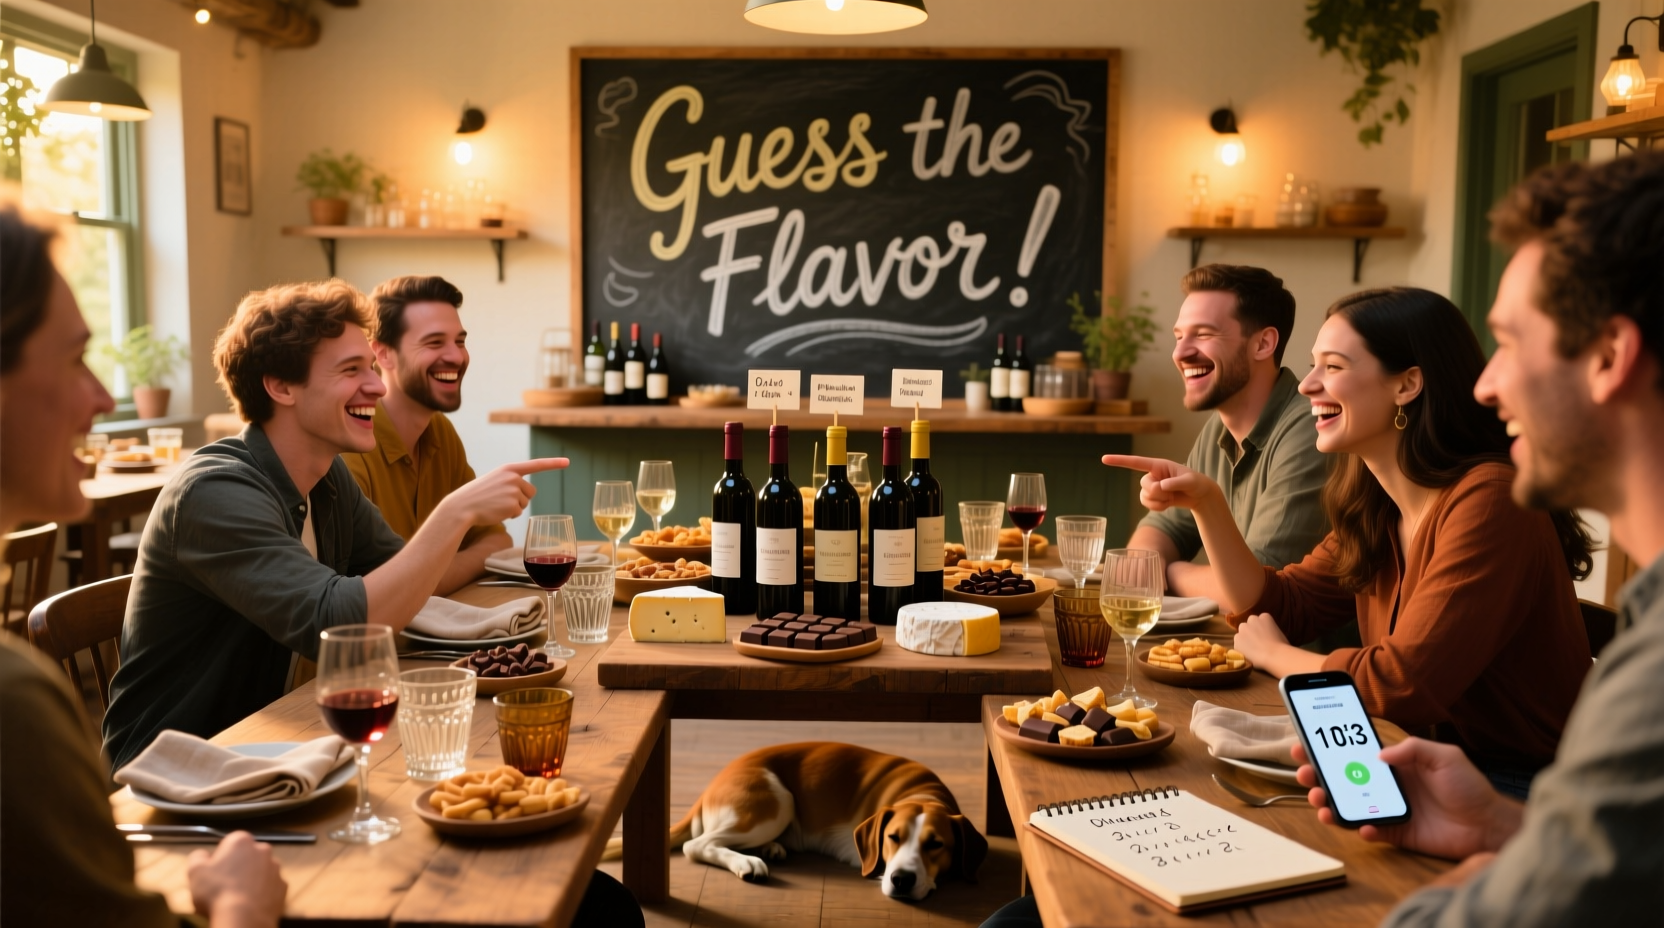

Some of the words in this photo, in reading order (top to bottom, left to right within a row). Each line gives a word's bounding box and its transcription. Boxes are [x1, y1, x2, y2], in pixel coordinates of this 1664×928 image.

[631, 85, 887, 260] Guess
[902, 87, 1032, 180] the
[700, 184, 1061, 337] Flavor!
